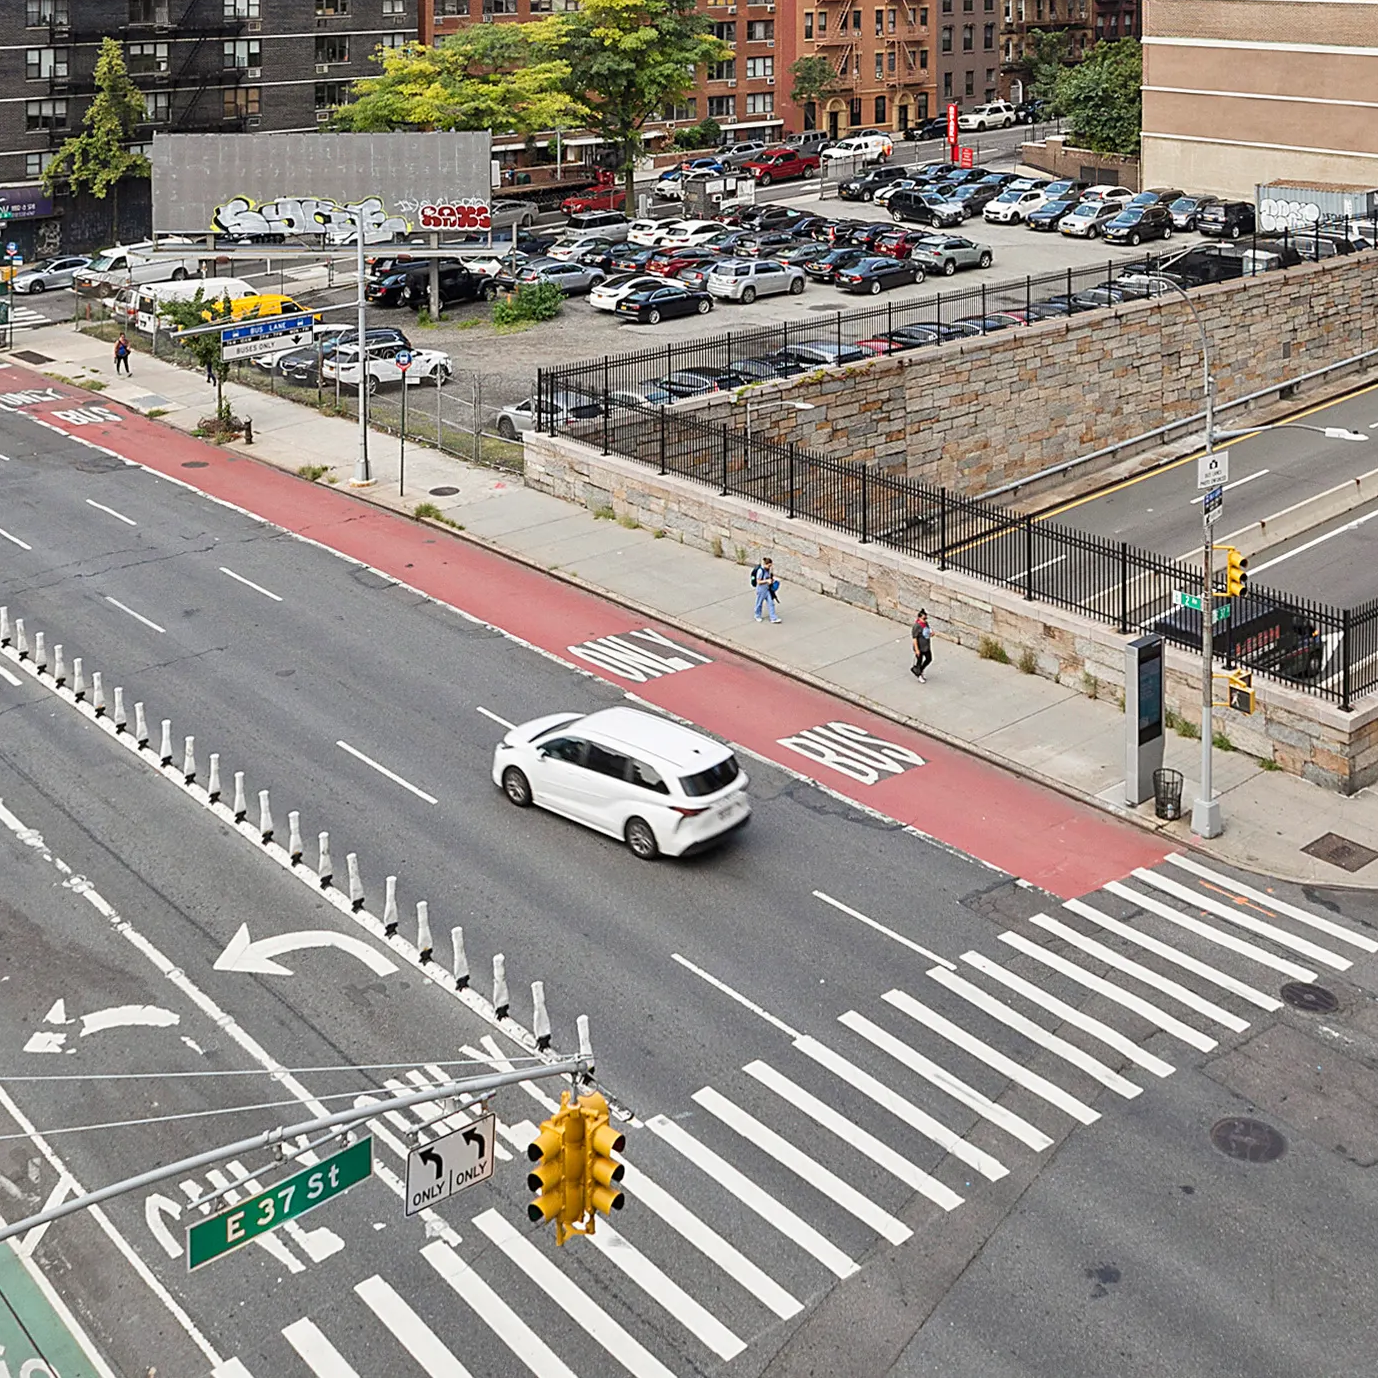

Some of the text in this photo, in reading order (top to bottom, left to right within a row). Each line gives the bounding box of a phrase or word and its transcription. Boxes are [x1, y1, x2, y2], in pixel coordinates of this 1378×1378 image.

[249, 321, 287, 335] BUS LANE
[236, 341, 276, 355] BUSES ONLY
[50, 406, 123, 426] BUS
[566, 627, 716, 683] ONLY
[775, 720, 926, 786] BUS
[456, 1160, 488, 1187] ONLY
[225, 1162, 341, 1244] E 37 St
[412, 1181, 446, 1207] ONLY
